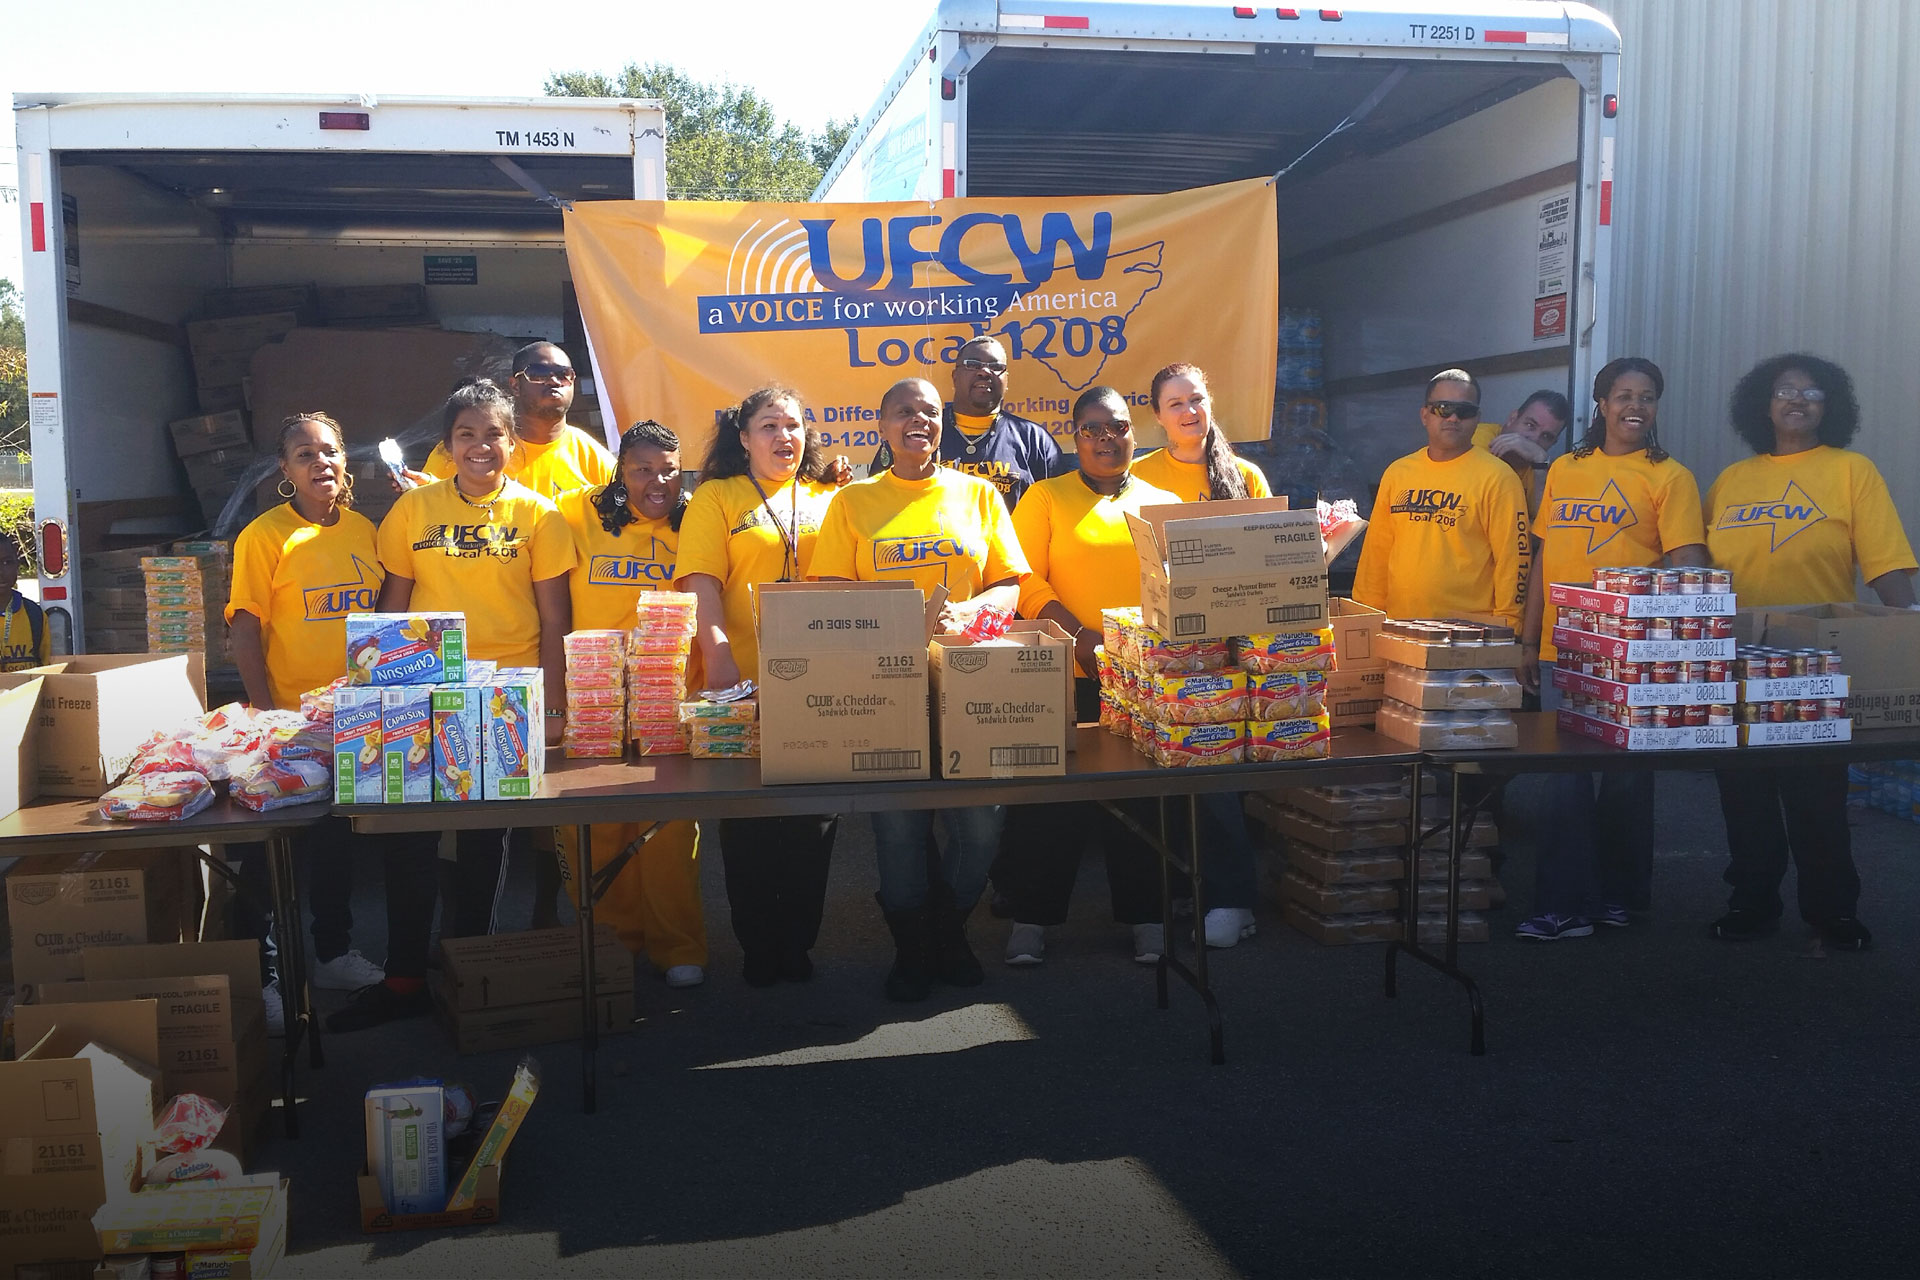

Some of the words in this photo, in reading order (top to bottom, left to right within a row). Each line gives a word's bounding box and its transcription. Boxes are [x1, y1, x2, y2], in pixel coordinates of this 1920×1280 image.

[1409, 24, 1427, 39] TT
[1430, 25, 1460, 40] 2251
[1465, 26, 1475, 40] D
[496, 130, 520, 146] TM
[524, 132, 559, 146] 1453
[563, 132, 575, 147] N
[799, 212, 1112, 291] UFCW
[708, 307, 724, 325] a
[728, 298, 824, 324] VOICE
[833, 297, 875, 320] for
[884, 292, 999, 319] working
[1007, 288, 1118, 312] America
[1000, 315, 1128, 360] 1208
[824, 407, 881, 423] Differ
[1000, 397, 1070, 415] orking
[1408, 490, 1462, 510] UFCW
[1560, 504, 1627, 524] UFCW
[1738, 504, 1814, 522] UFCW
[1295, 520, 1314, 528] PLACE
[439, 525, 518, 543] UFCW
[1274, 532, 1316, 544] FRAGILE
[1516, 512, 1530, 557] Local
[445, 548, 480, 558] Local
[486, 548, 518, 558] 1208
[898, 538, 976, 562] UFCW
[1289, 575, 1318, 585] 47324
[1515, 562, 1529, 604] 1208
[1212, 585, 1233, 593] Cheese
[1238, 583, 1258, 592] Peanut
[1579, 595, 1601, 608] TOMATO
[1695, 596, 1725, 612] 00011
[808, 619, 823, 630] UP
[826, 619, 852, 630] SIDE
[855, 619, 880, 629] THIS
[1281, 632, 1313, 642] Maruchan
[1274, 640, 1294, 650] Souper
[1580, 638, 1600, 651] TOMATO
[1696, 642, 1726, 657] 00011
[878, 655, 915, 667] 21161
[1017, 650, 1054, 661] 21161
[1191, 676, 1224, 684] Maruchan
[1360, 674, 1385, 682] 47324
[1184, 685, 1205, 695] Souper
[1580, 680, 1600, 695] TOMATO
[1696, 685, 1726, 701] 00011
[1810, 680, 1834, 695] 01251
[58, 696, 92, 710] Freeze
[806, 694, 833, 708] CLUB
[843, 694, 887, 707] Cheddar
[1848, 694, 1890, 711] Refrige
[818, 708, 848, 717] Sandwich
[850, 707, 876, 716] Crackers
[965, 702, 992, 716] CLUB
[994, 704, 1001, 714] &
[1002, 702, 1046, 714] Cheddar
[976, 715, 1006, 725] Sandwich
[1009, 715, 1034, 724] Crackers
[1884, 710, 1912, 723] Buns
[1197, 726, 1228, 734] Maruchan
[1279, 720, 1311, 728] Maruchan
[1812, 723, 1837, 739] 01251
[1189, 736, 1210, 744] Souper
[1695, 729, 1726, 744] 00011
[949, 751, 961, 774] 2
[89, 878, 130, 890] 21161
[75, 931, 123, 944] Cheddar
[20, 984, 33, 1006] 2
[198, 989, 220, 997] PLACE
[170, 1003, 221, 1015] FRAGILE
[176, 1048, 220, 1062] 21161
[38, 1144, 86, 1159] 21161
[175, 1162, 210, 1178] Hostess
[23, 1208, 79, 1223] Cheddar
